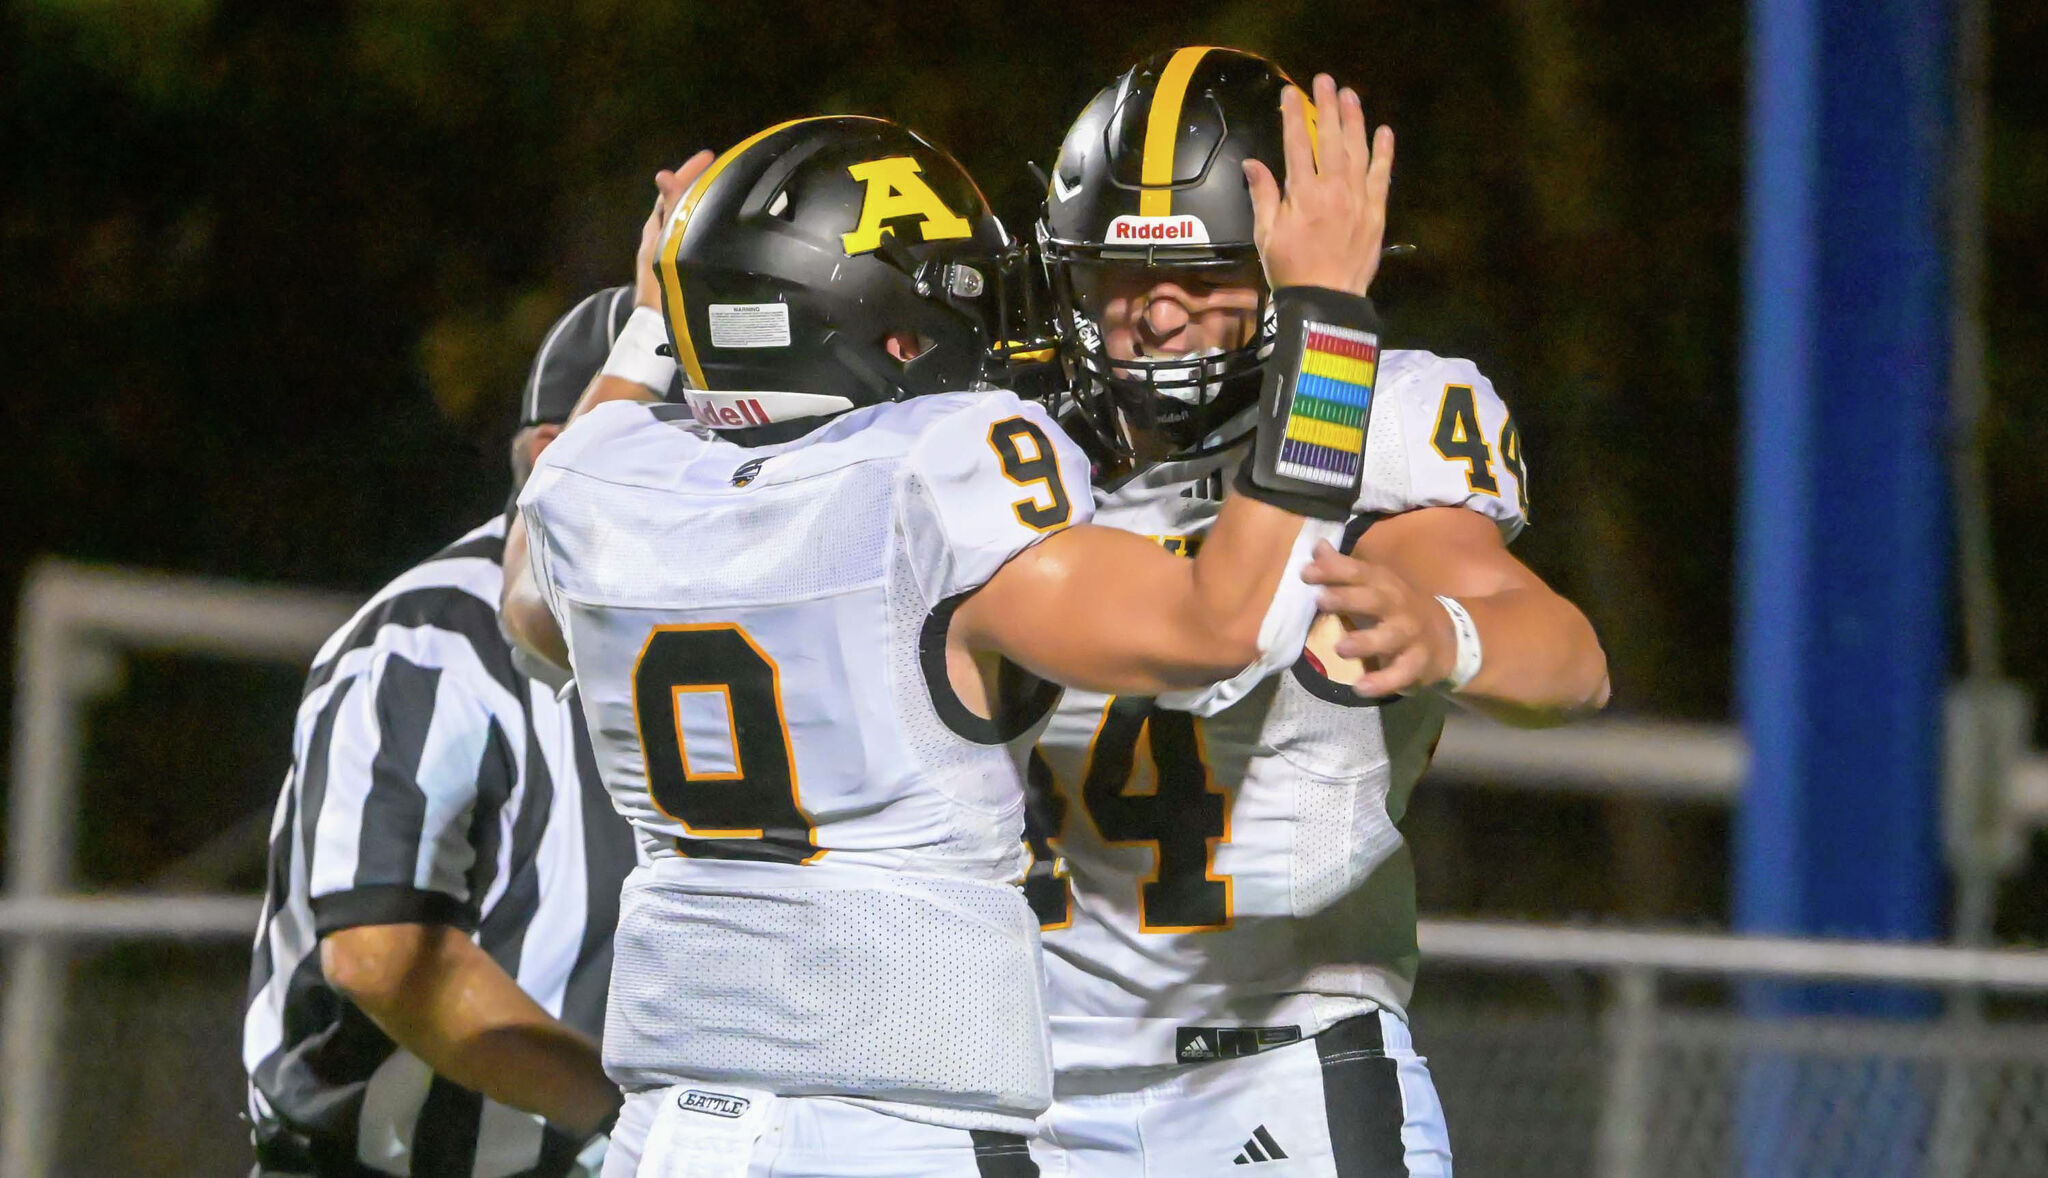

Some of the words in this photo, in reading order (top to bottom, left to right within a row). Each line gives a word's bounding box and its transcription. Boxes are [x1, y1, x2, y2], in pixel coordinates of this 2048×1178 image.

[842, 156, 972, 257] A
[1116, 221, 1193, 239] Riddell
[986, 414, 1073, 534] 9
[630, 621, 829, 867] 9
[684, 1093, 743, 1115] BATTLE
